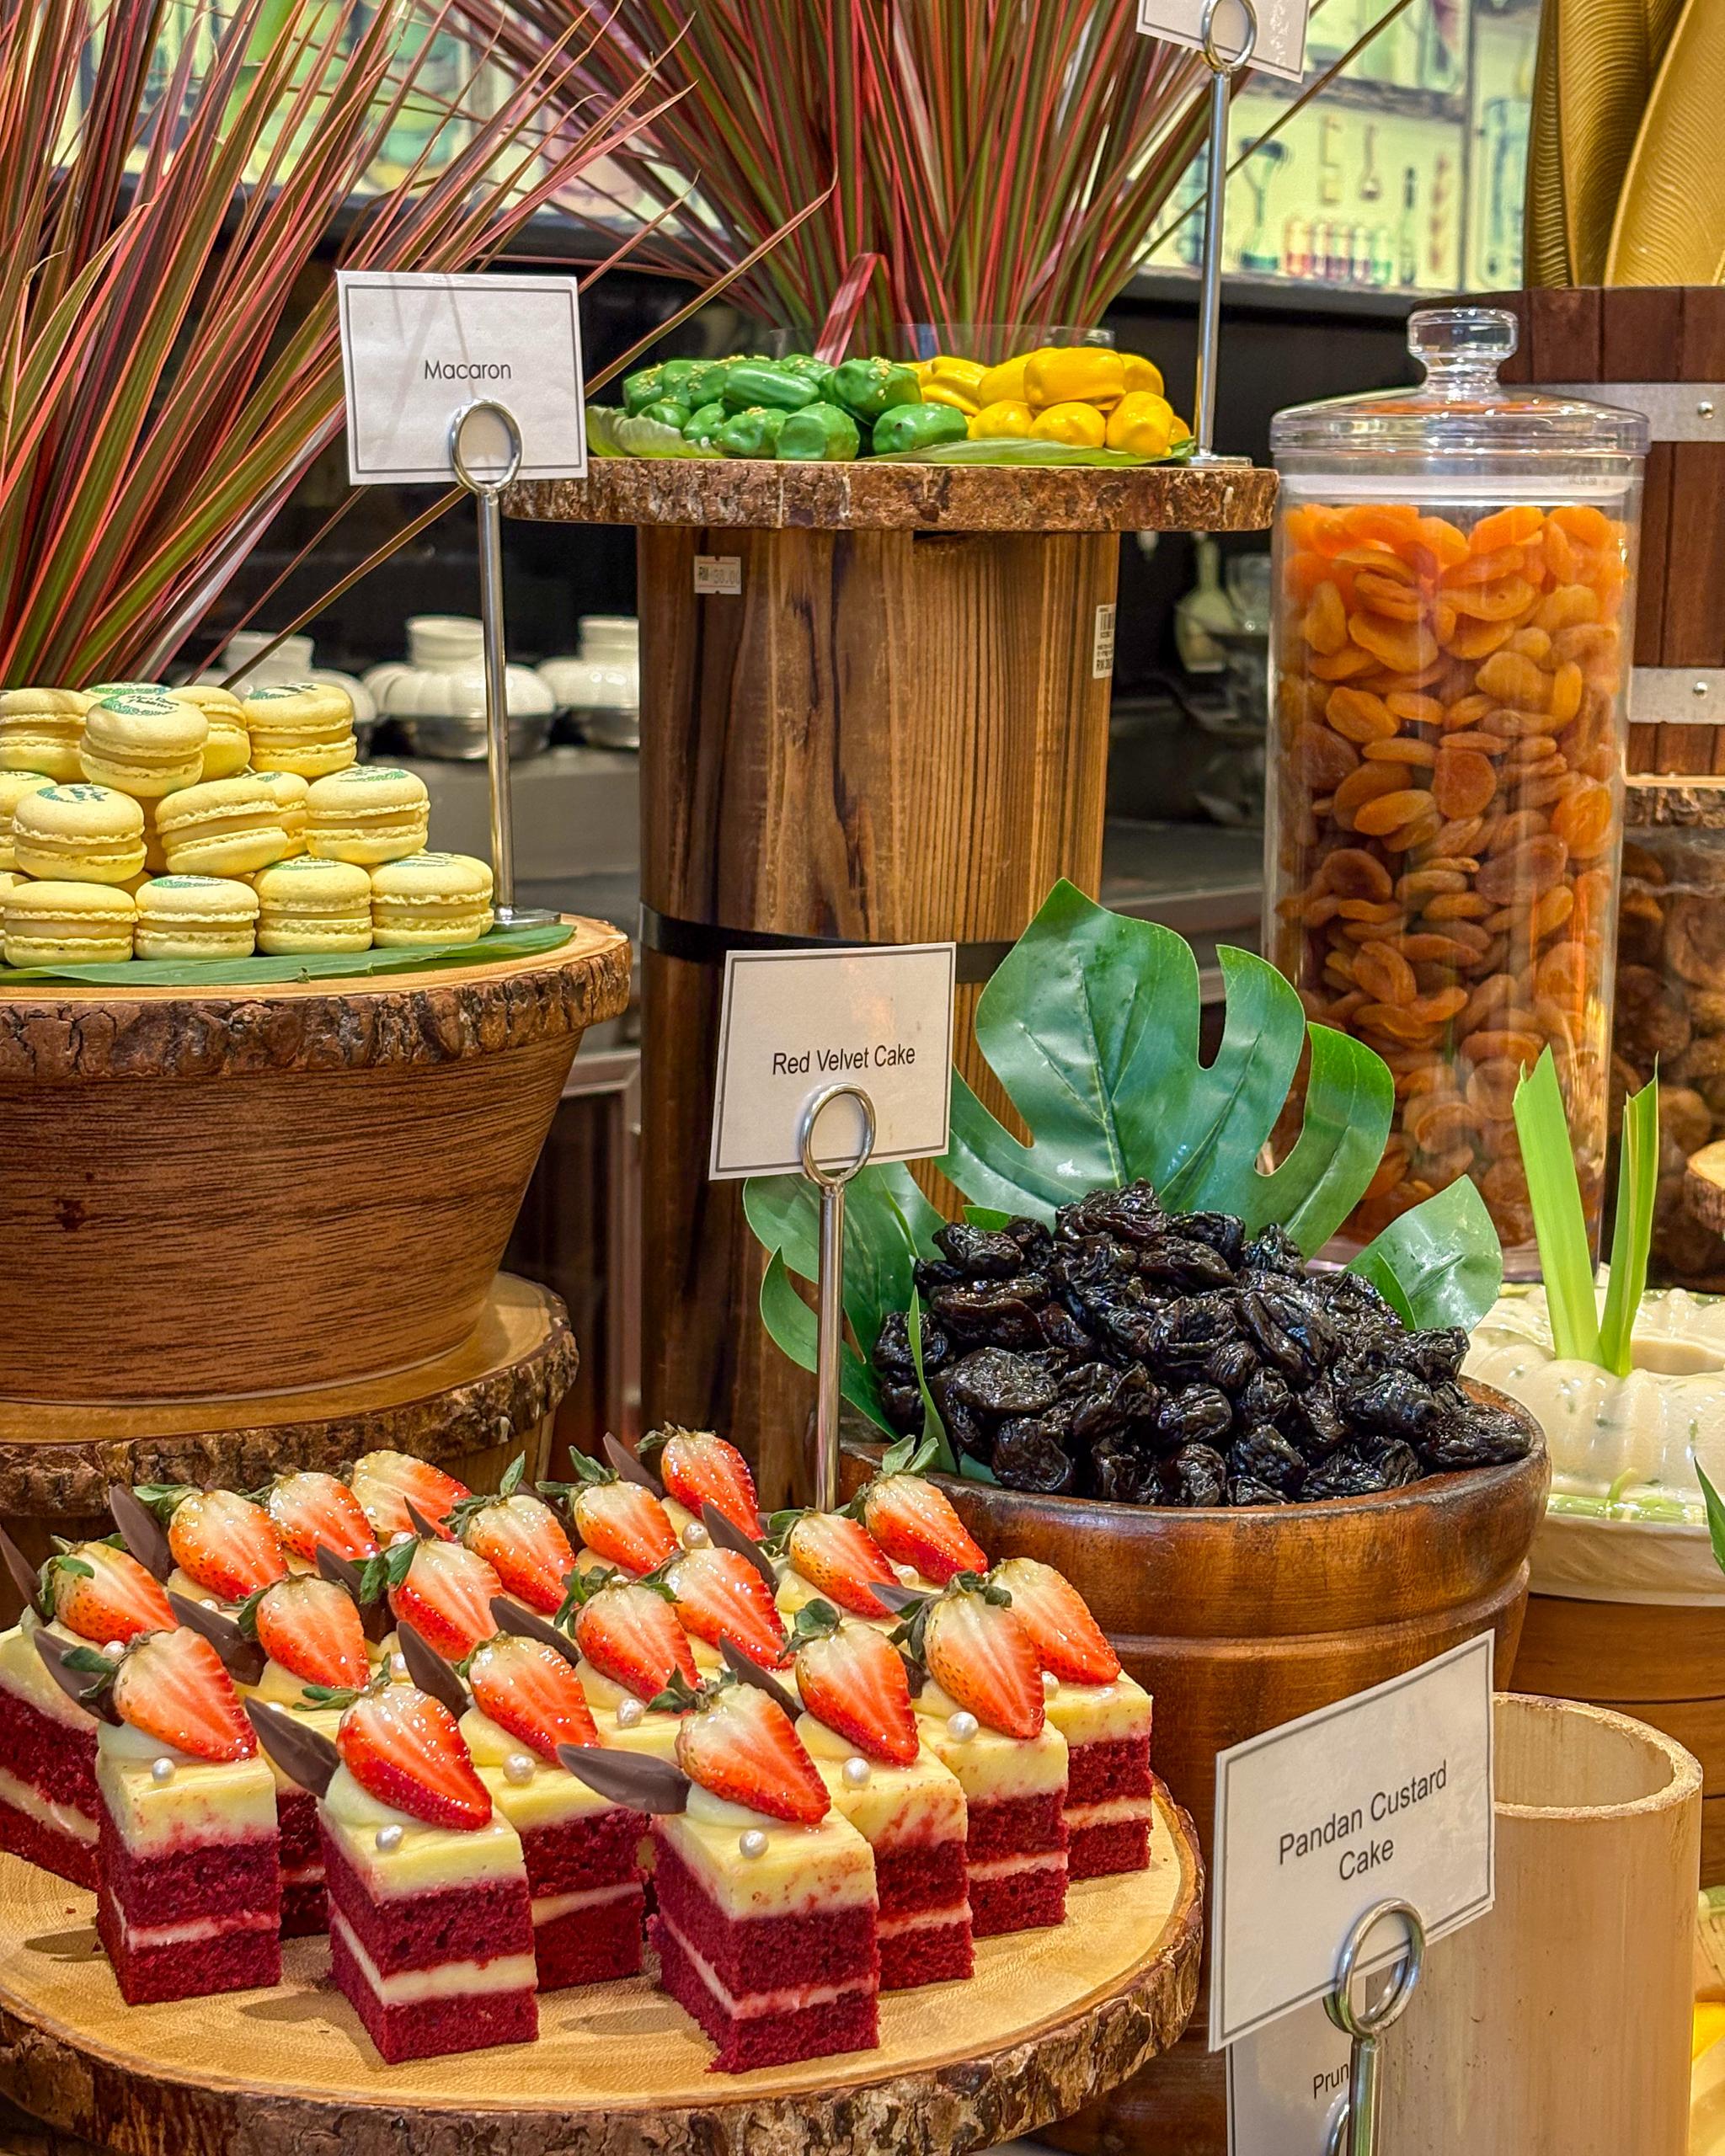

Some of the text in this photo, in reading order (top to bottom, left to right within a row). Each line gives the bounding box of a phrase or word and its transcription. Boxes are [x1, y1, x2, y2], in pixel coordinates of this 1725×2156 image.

[424, 359, 512, 380] Macaron
[772, 1043, 916, 1075] Red Velvet Cake
[1279, 1758, 1447, 1865] Pandan Custard
[1339, 1838, 1394, 1881] Cake
[1313, 2063, 1349, 2100] Prun
